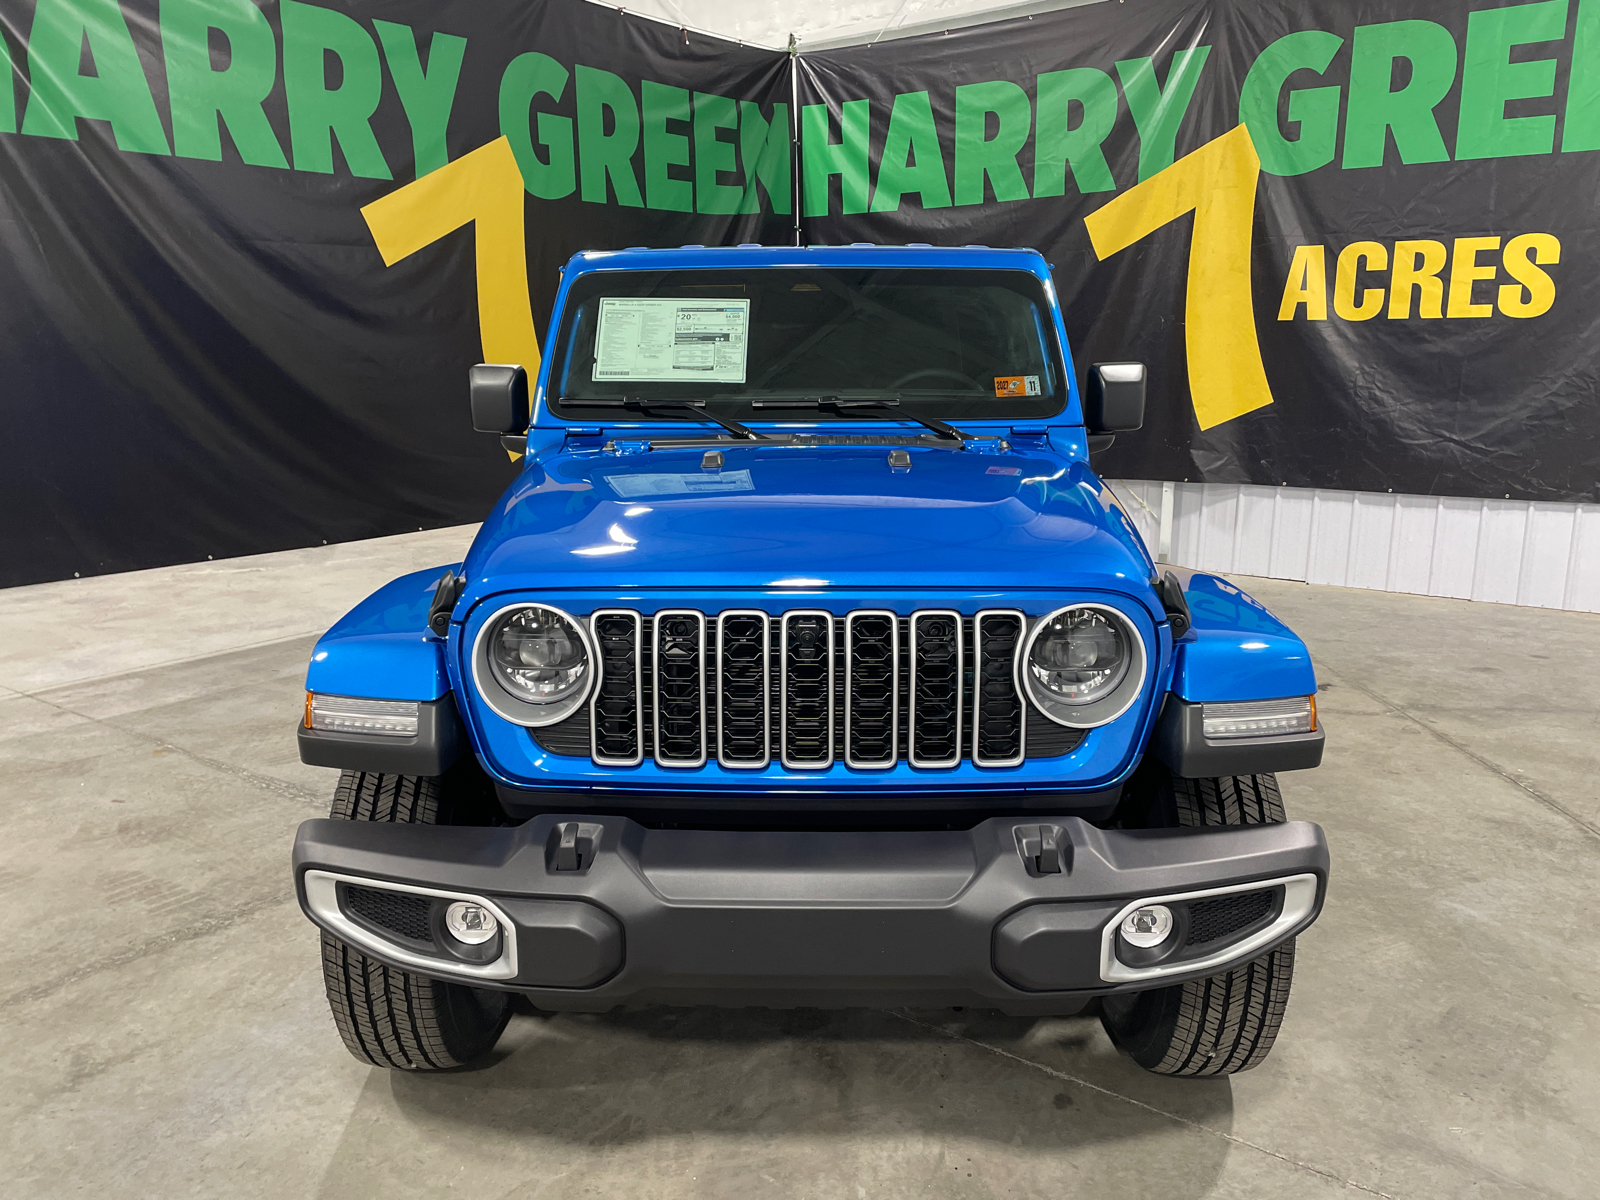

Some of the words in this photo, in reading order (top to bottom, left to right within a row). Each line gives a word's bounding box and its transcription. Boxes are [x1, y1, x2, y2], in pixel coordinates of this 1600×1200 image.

[0, 0, 467, 180] ARRY
[499, 52, 790, 215] GREEN
[802, 45, 1211, 217] HARRY
[360, 135, 542, 463] 7
[1084, 122, 1274, 431] 7
[1278, 232, 1561, 321] ACRES
[996, 380, 1009, 390] 2027
[1029, 380, 1036, 391] 11
